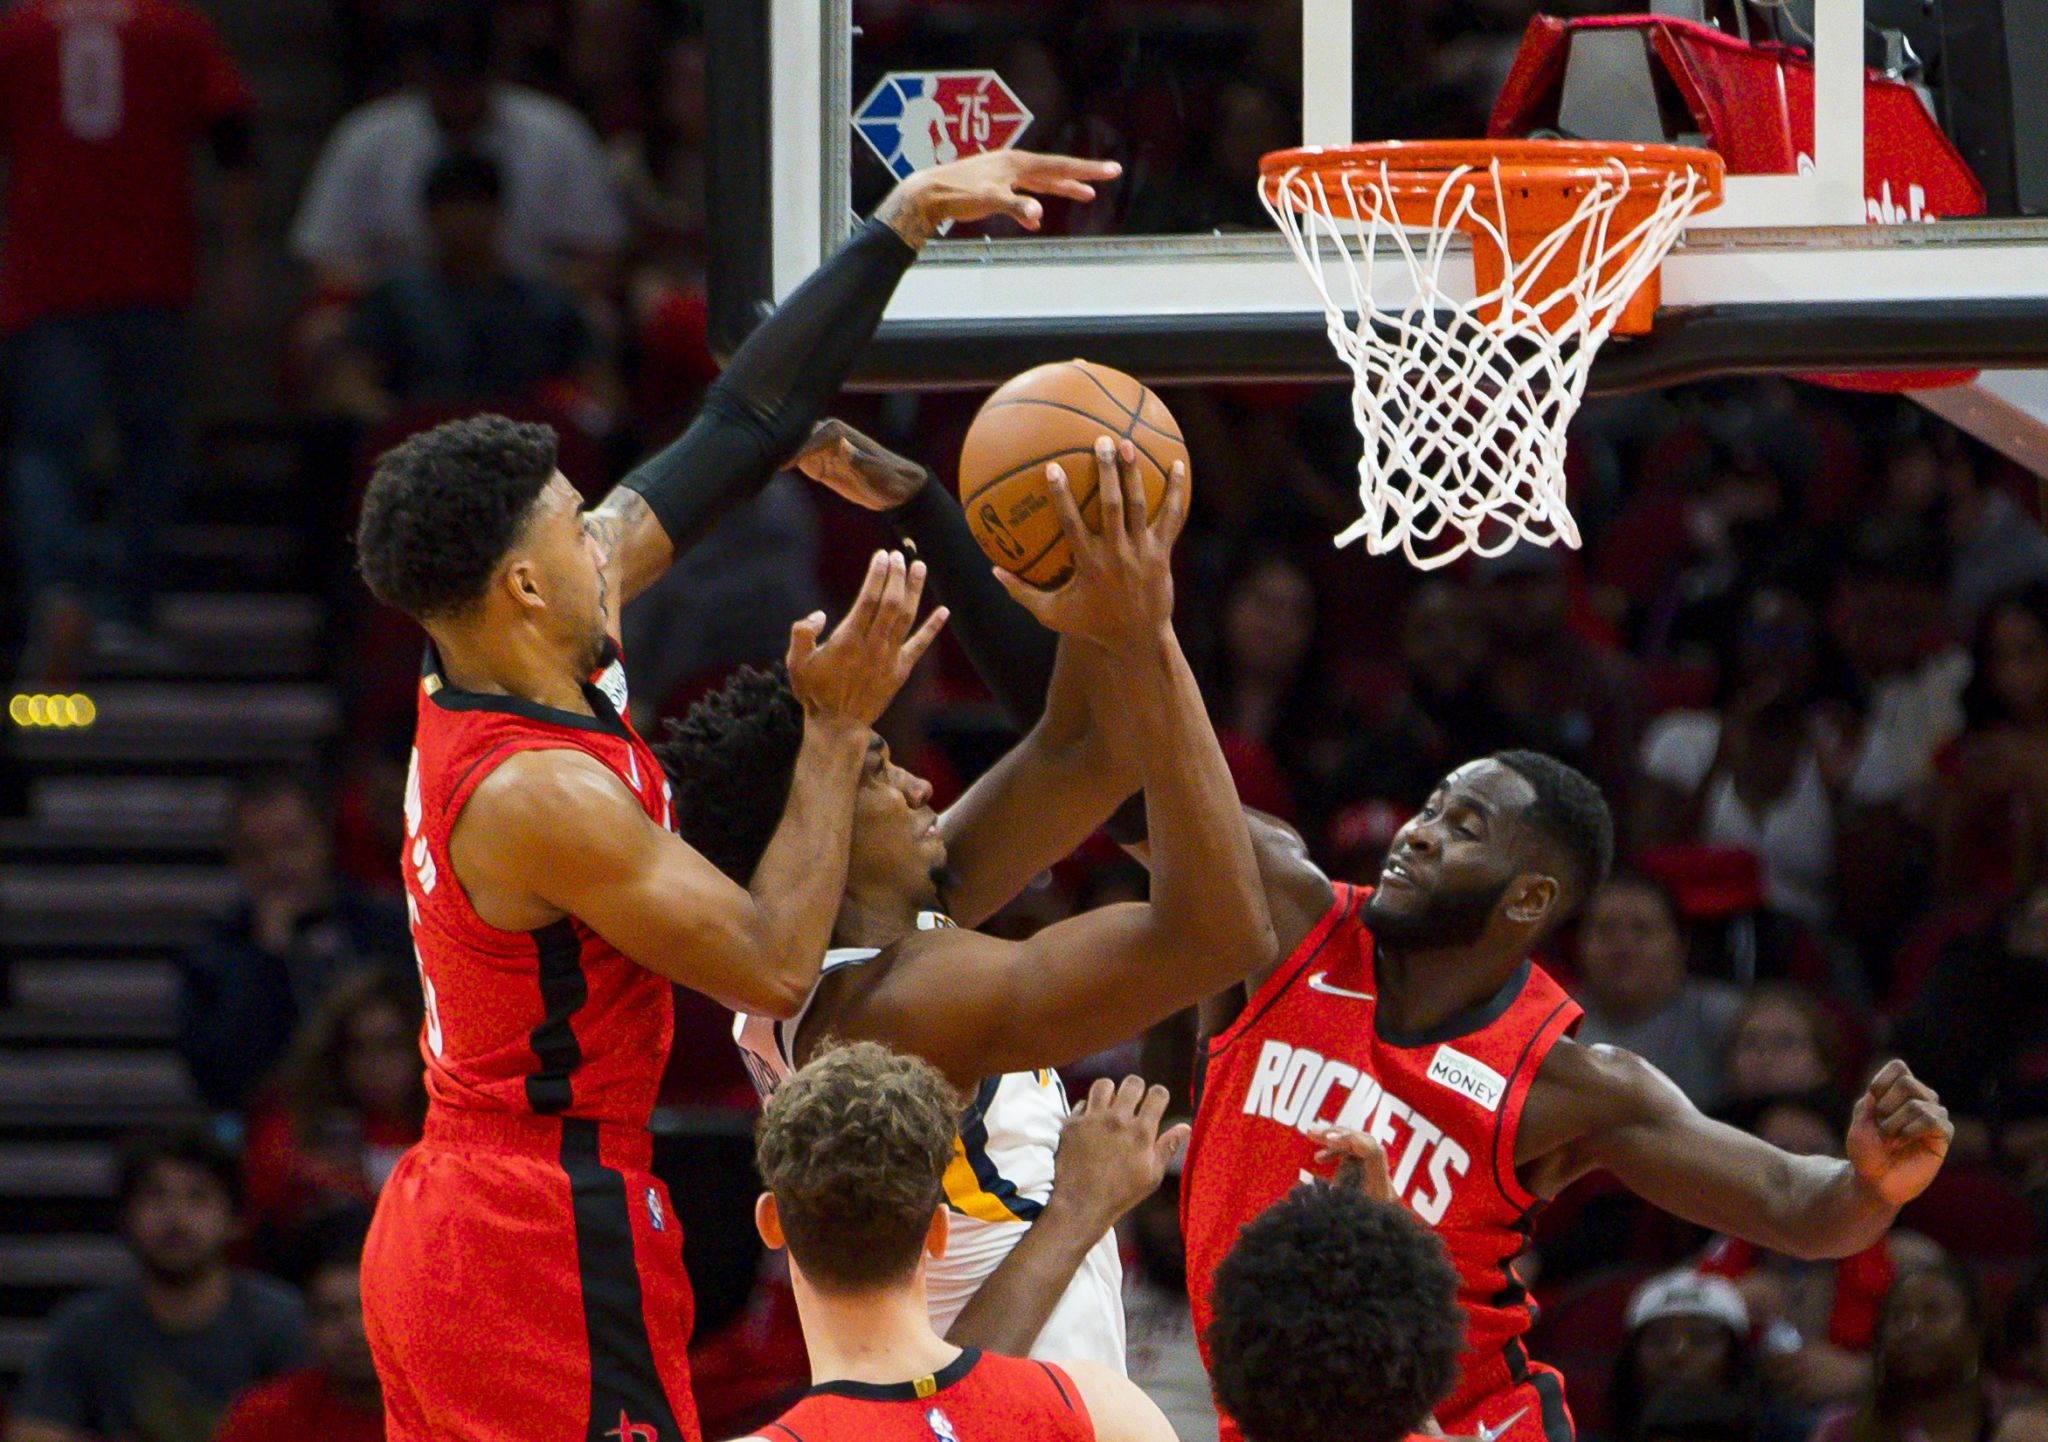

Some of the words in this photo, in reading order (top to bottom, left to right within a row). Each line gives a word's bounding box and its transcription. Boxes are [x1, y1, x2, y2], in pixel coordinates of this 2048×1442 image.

[956, 95, 990, 143] 75
[1431, 1061, 1498, 1104] MONEY
[1242, 1039, 1470, 1227] ROCKETS
